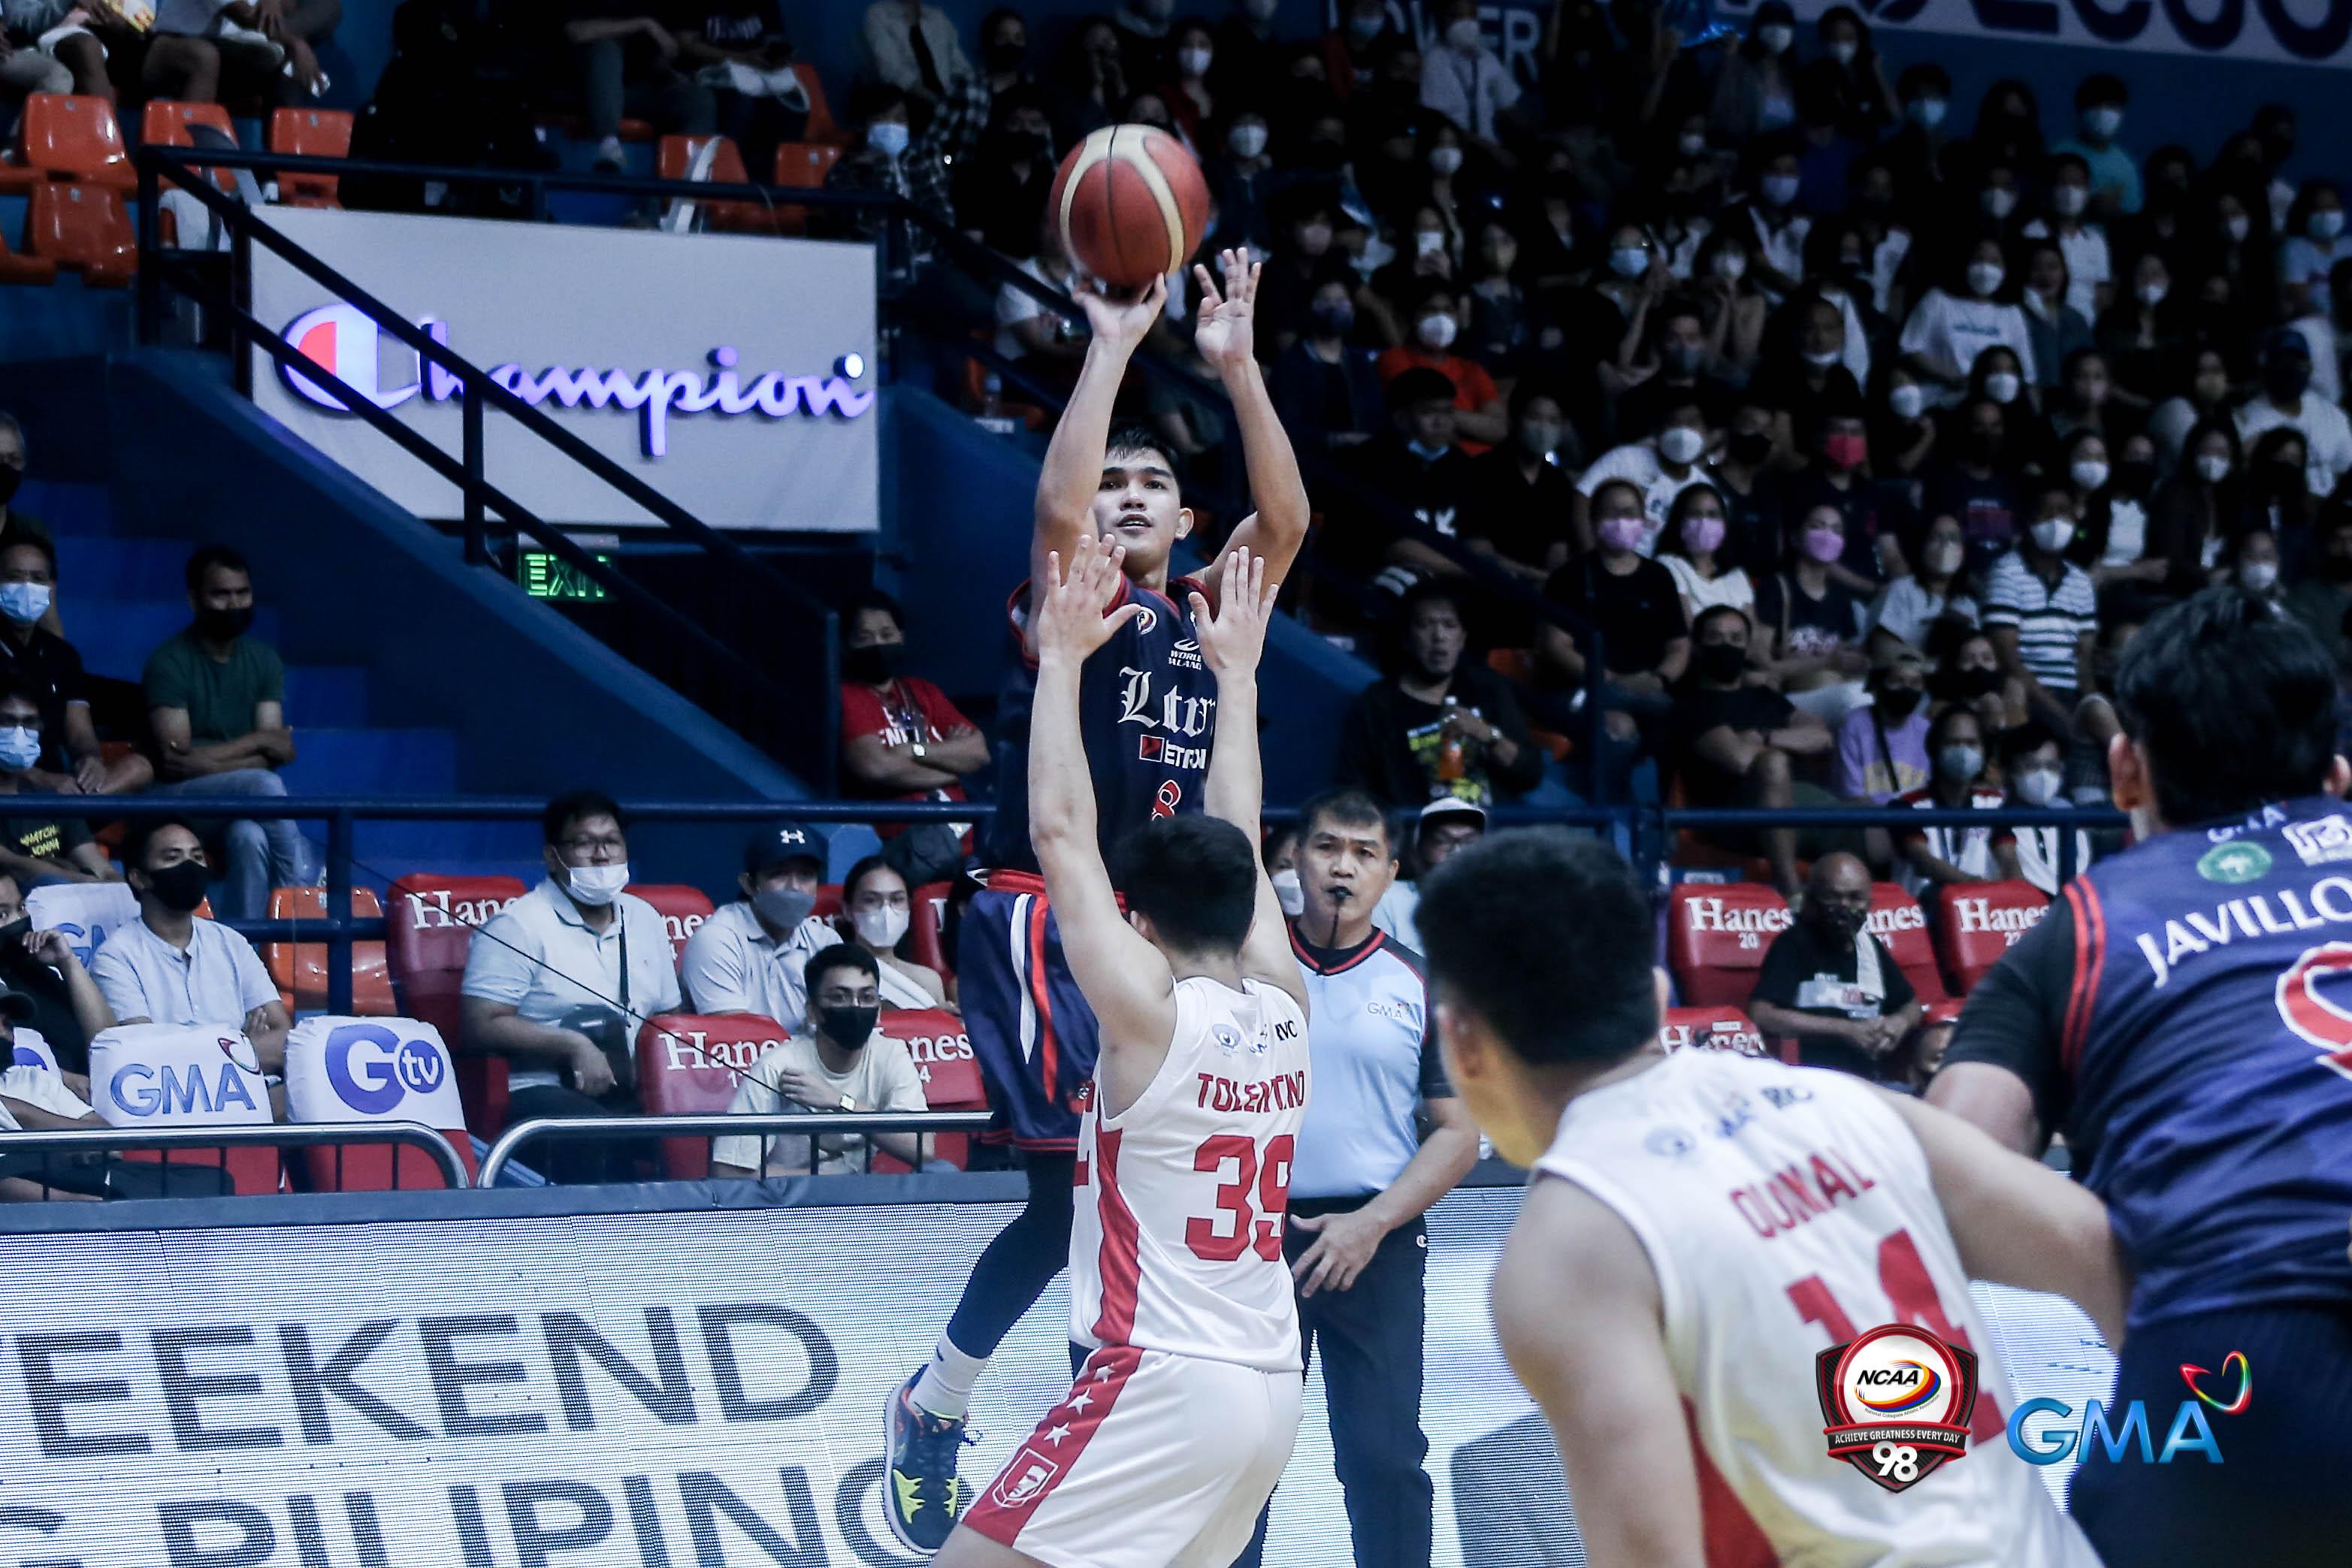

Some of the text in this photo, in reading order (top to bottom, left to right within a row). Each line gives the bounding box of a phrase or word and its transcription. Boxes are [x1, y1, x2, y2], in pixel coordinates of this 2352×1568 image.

[275, 304, 874, 458] Champion
[1738, 932, 1759, 950] 20
[658, 1032, 791, 1071] Hane
[110, 1063, 257, 1116] GMA
[1197, 1070, 1304, 1113] TOLENTNO
[1185, 1134, 1295, 1262] 39
[14, 1303, 840, 1459] EEKEND
